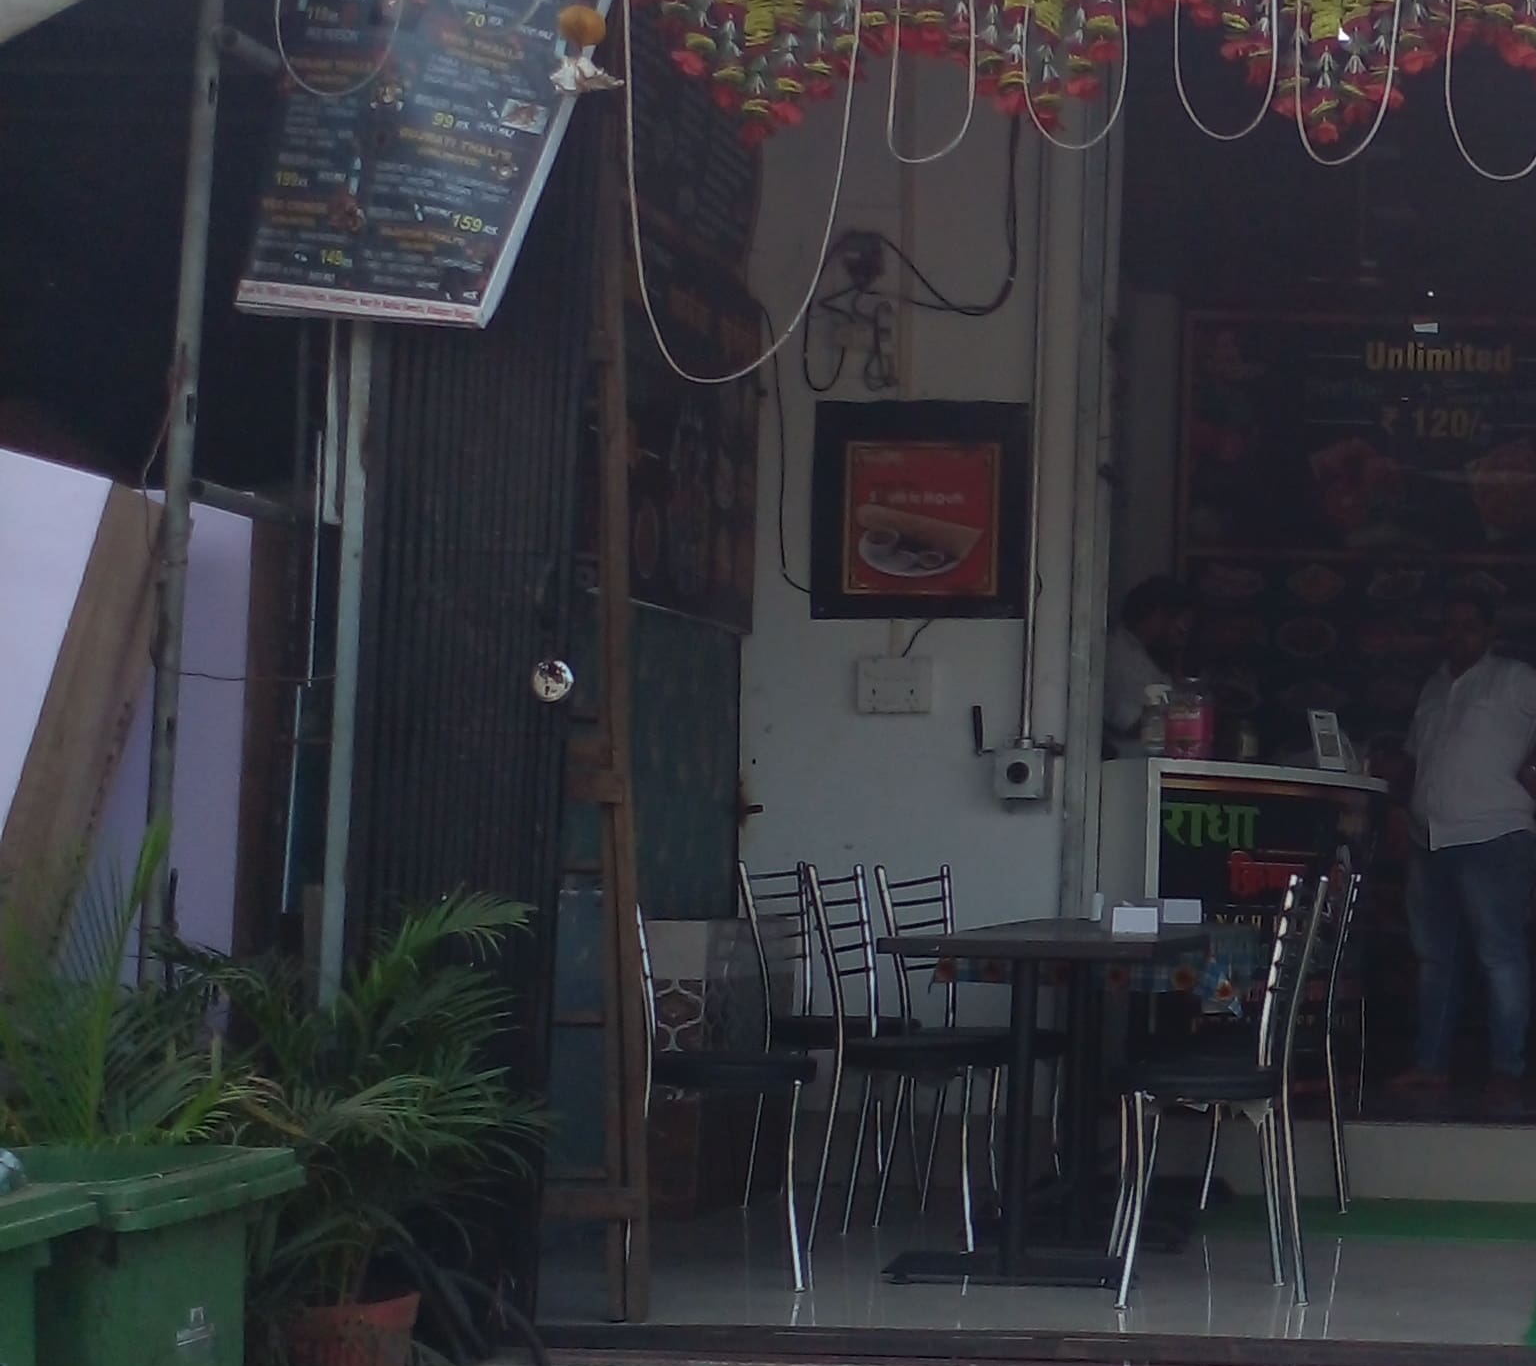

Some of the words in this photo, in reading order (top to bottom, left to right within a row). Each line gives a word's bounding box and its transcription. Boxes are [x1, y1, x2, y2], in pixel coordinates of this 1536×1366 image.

[453, 212, 483, 234] 159
[1365, 339, 1514, 374] Unlimited
[1162, 801, 1261, 850] राधा
